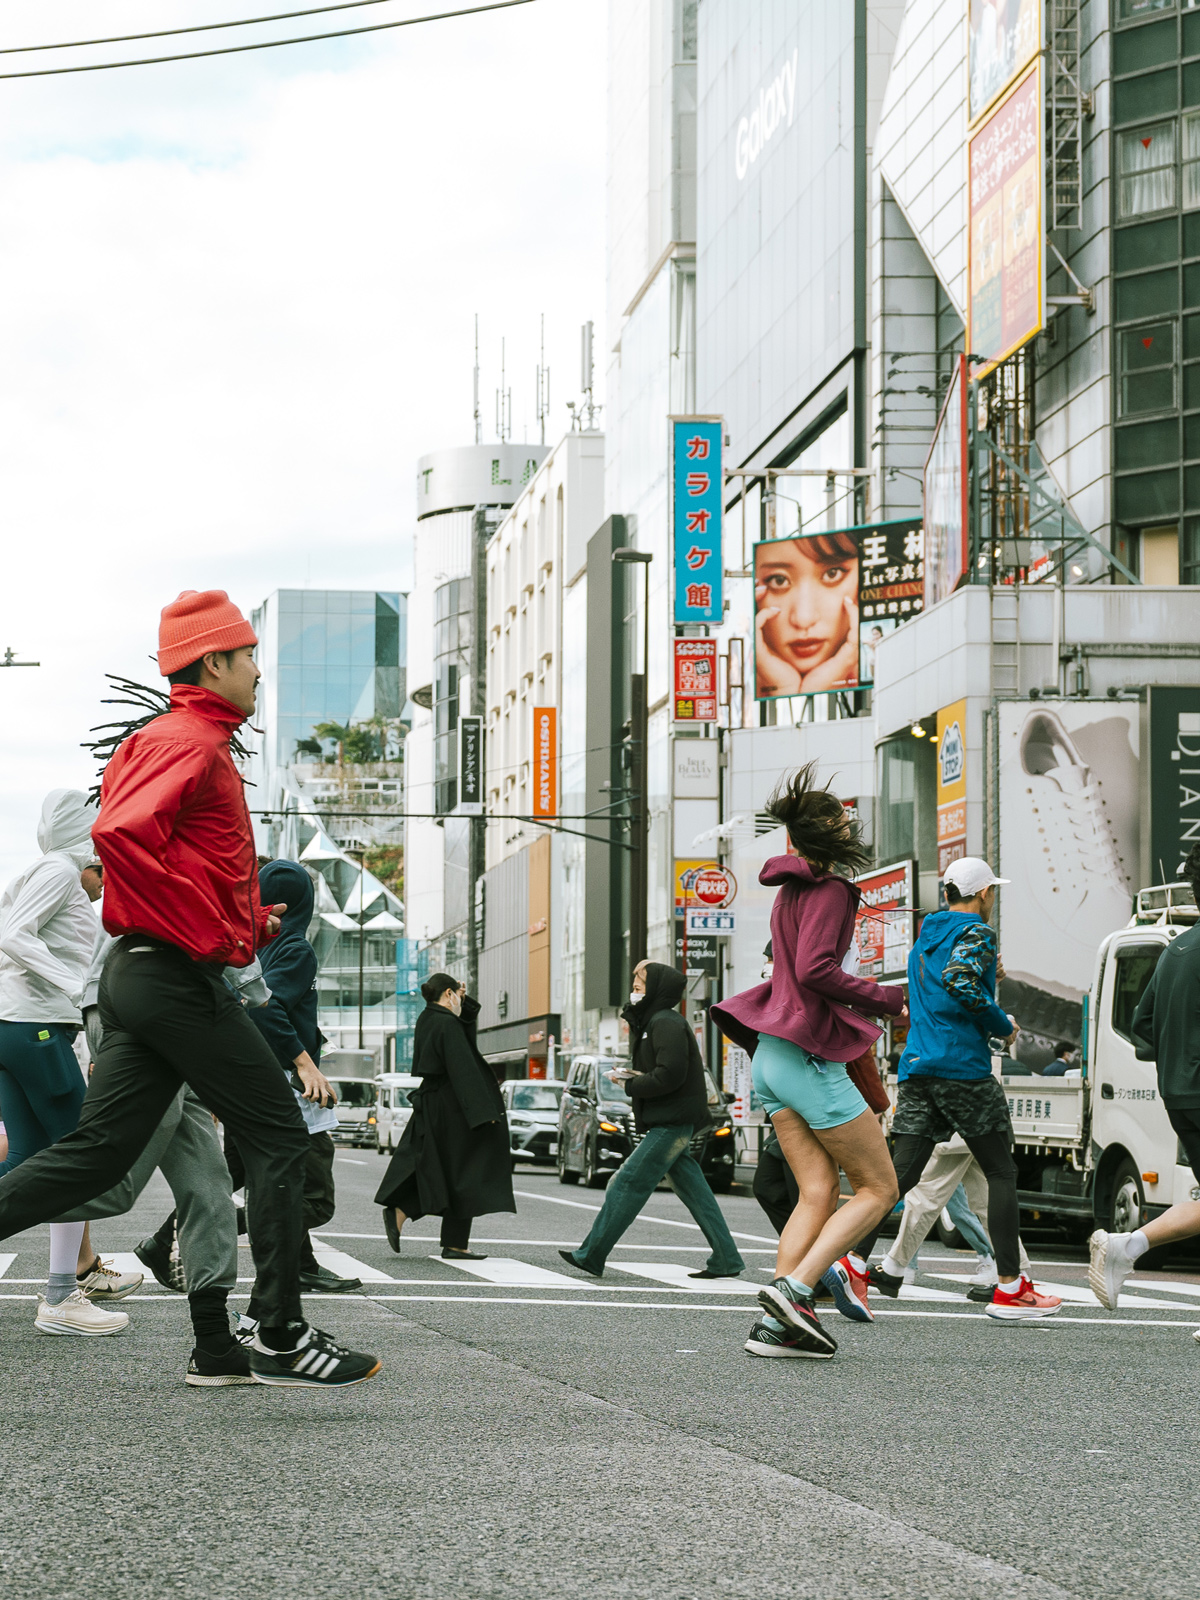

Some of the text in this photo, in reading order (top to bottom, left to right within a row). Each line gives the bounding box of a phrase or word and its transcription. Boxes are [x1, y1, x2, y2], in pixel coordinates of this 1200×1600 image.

[735, 48, 798, 180] Galaxy
[686, 436, 711, 608] カラオケ館
[860, 588, 884, 601] ONE
[540, 714, 551, 812] OSHMAN'S
[945, 756, 959, 776] STOP
[697, 880, 727, 895] 消火栓
[694, 917, 730, 928] KEN
[41, 1306, 66, 1319] HOKA
